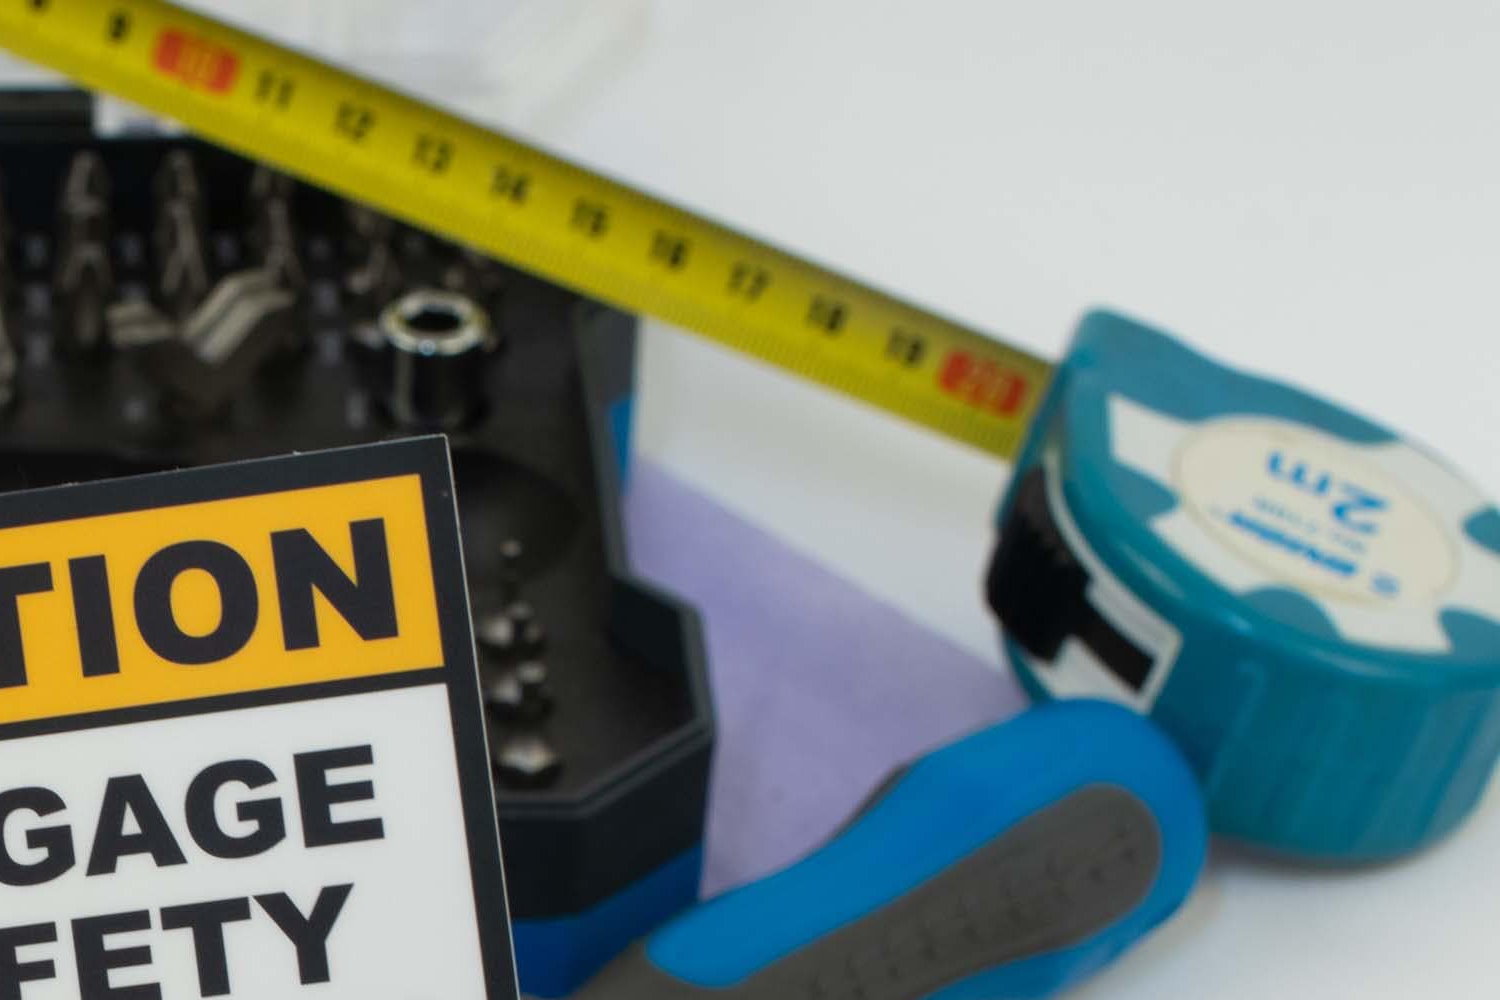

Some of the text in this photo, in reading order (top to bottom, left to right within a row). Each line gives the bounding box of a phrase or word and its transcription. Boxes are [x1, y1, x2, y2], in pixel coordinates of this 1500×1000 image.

[255, 69, 297, 112] 11
[334, 102, 375, 143] 12
[411, 131, 455, 175] 13
[489, 163, 533, 207] 14
[727, 260, 771, 302] 17
